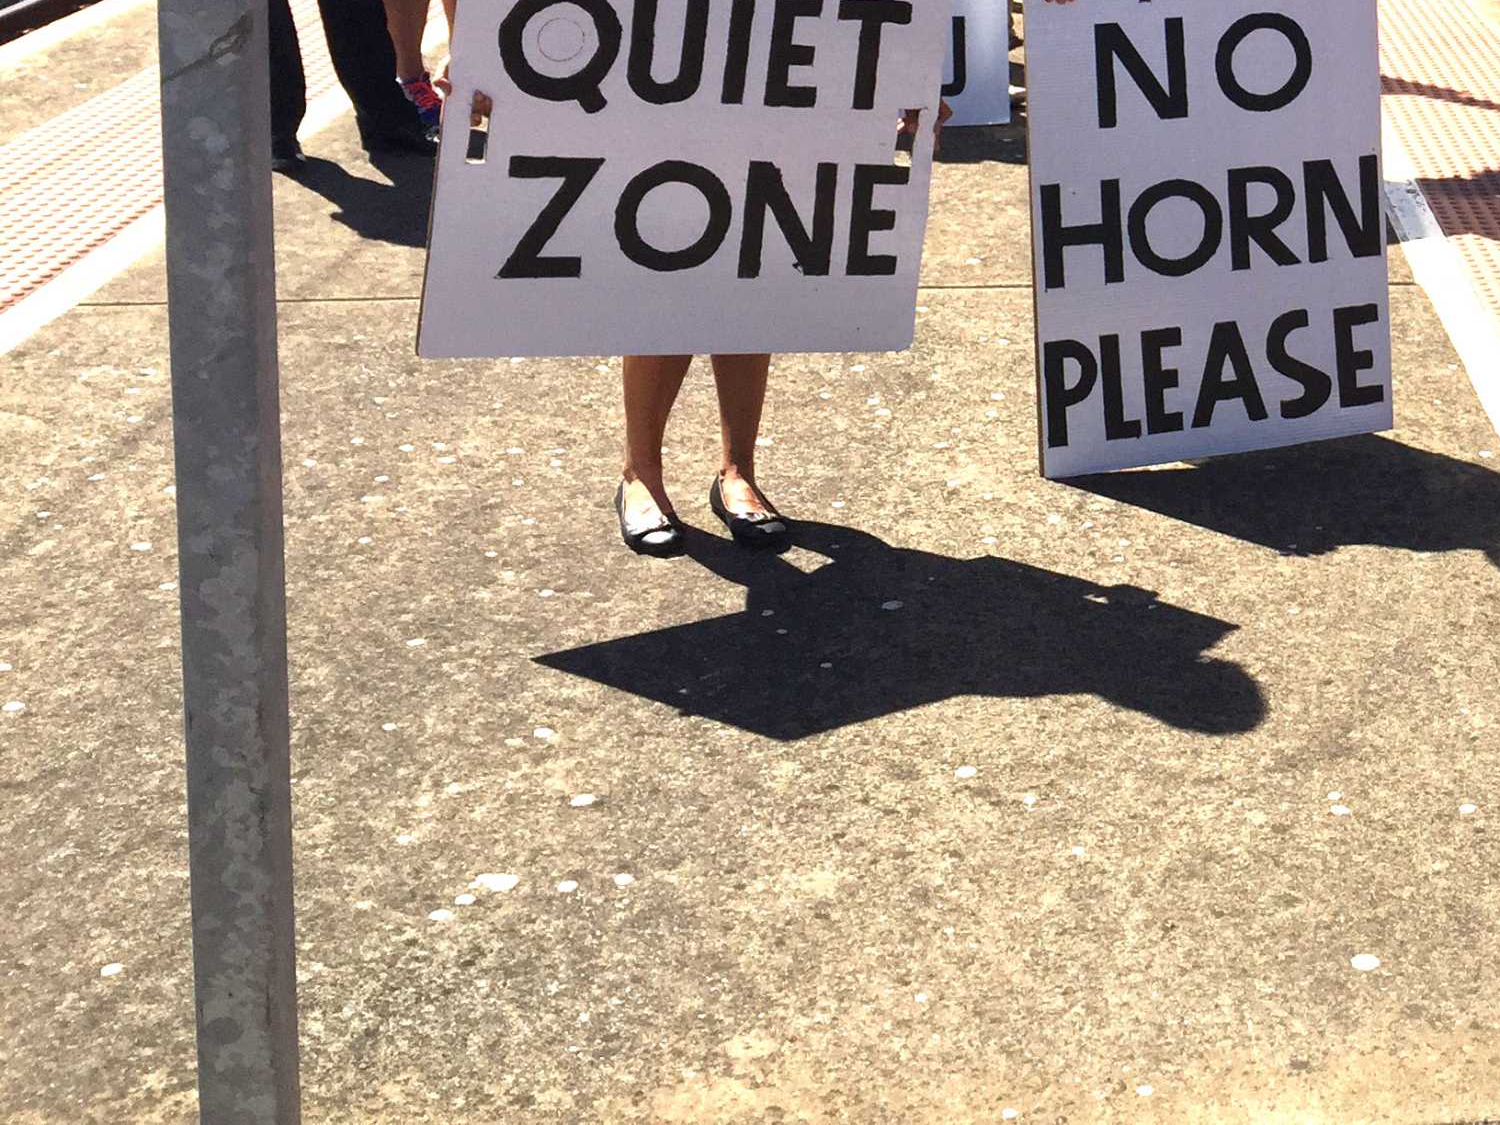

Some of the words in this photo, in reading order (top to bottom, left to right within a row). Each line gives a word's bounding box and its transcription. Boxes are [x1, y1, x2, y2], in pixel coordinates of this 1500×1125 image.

[1094, 12, 1312, 129] NO
[494, 155, 911, 279] ZONE
[1040, 155, 1382, 291] HORN
[1044, 303, 1384, 448] PLEASE
